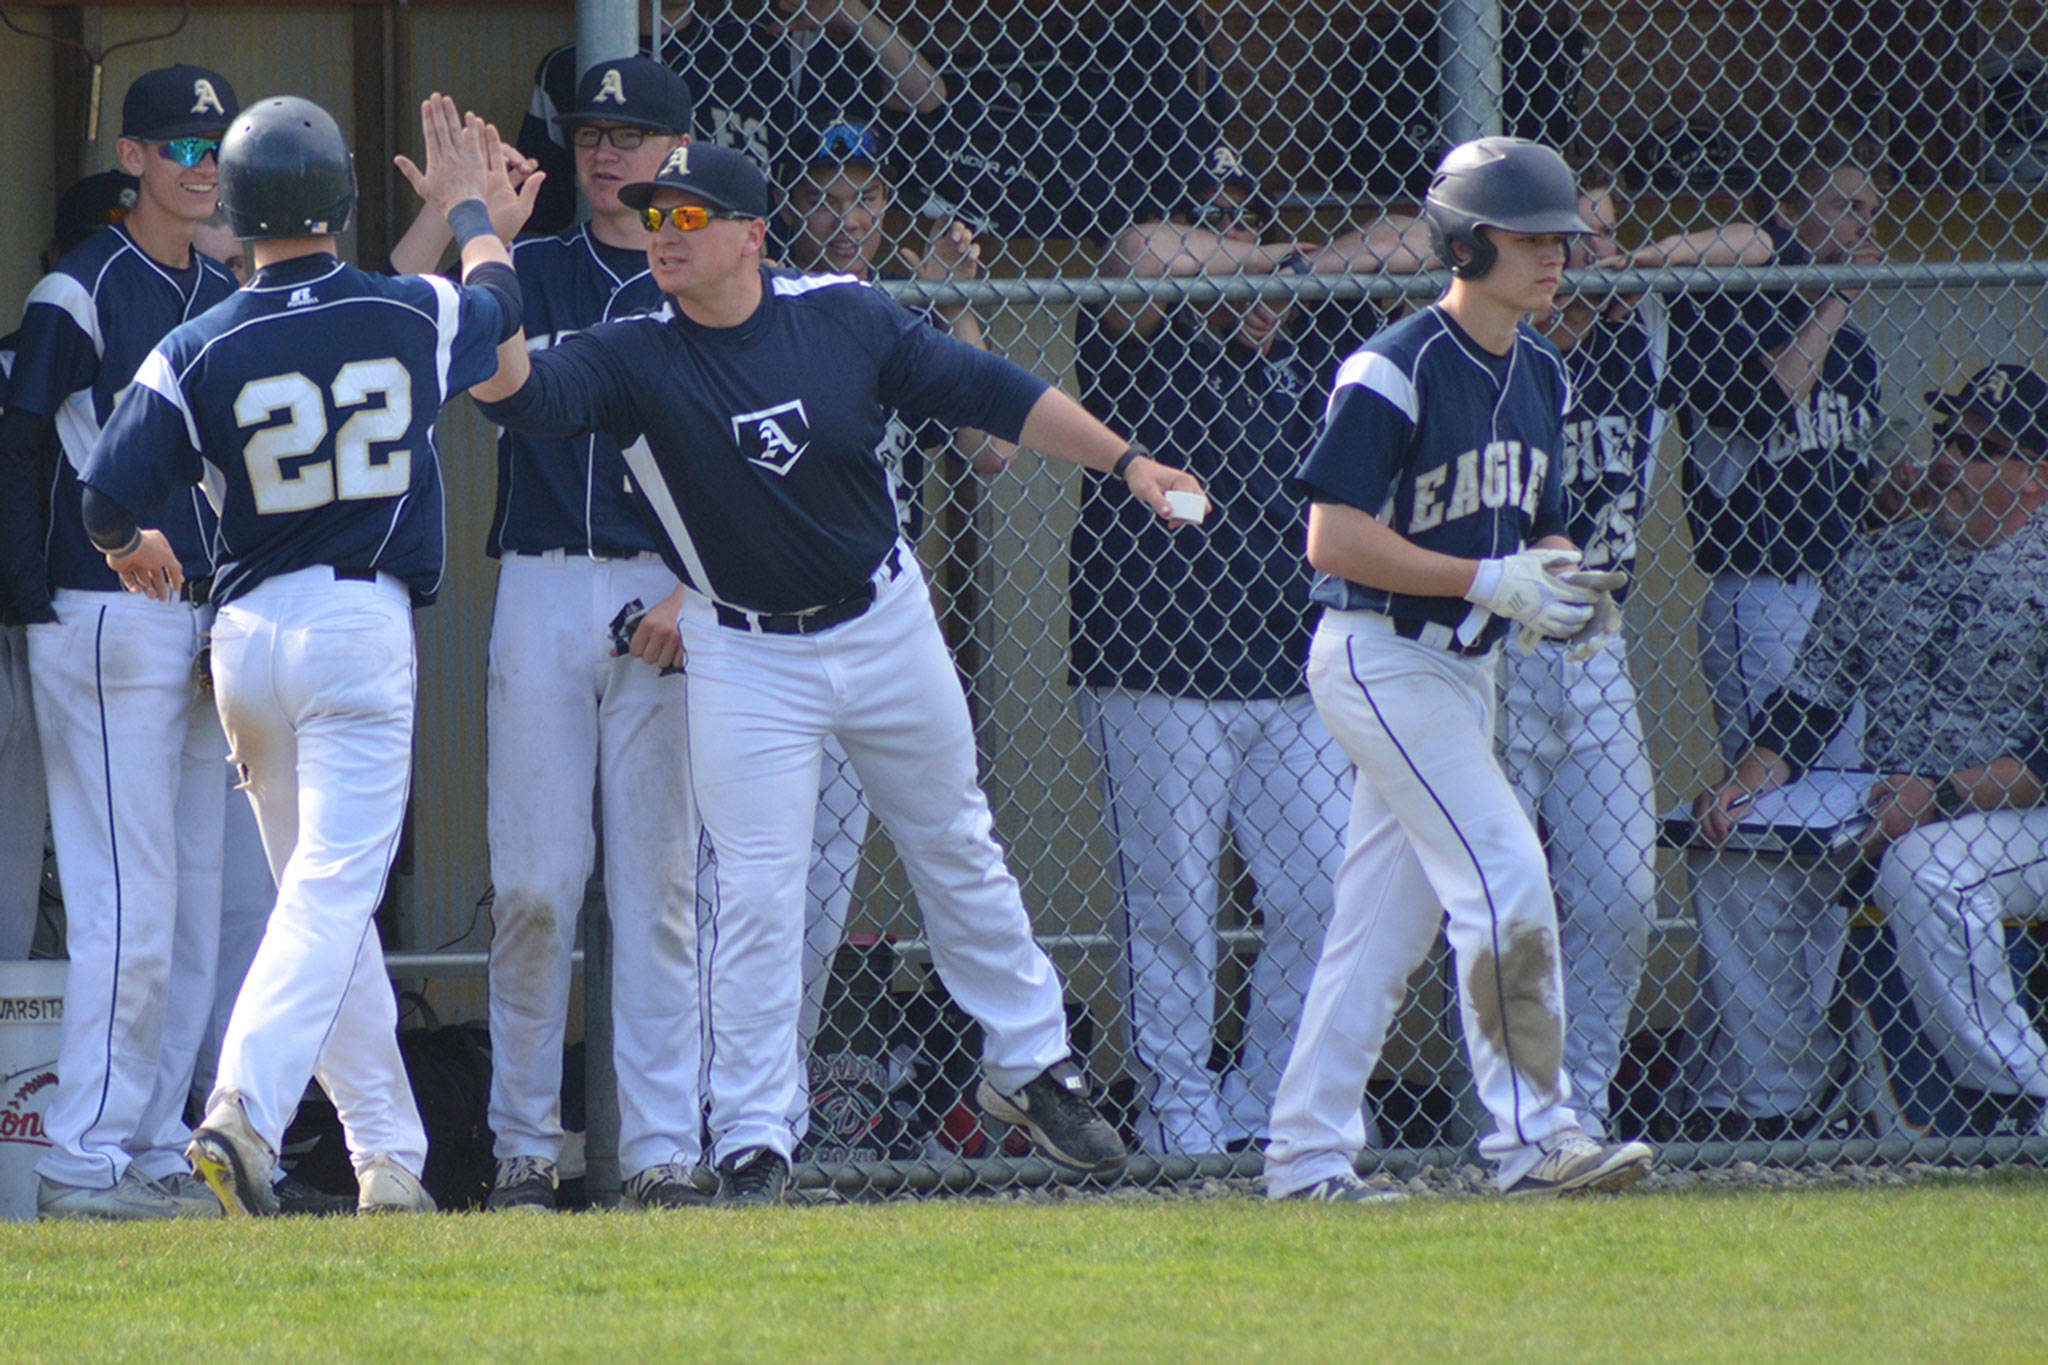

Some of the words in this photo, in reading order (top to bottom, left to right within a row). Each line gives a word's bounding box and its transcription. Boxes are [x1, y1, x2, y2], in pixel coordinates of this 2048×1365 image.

[190, 77, 225, 116] A
[594, 68, 627, 105] A
[658, 146, 691, 177] A
[233, 357, 412, 515] 22
[760, 418, 799, 460] A
